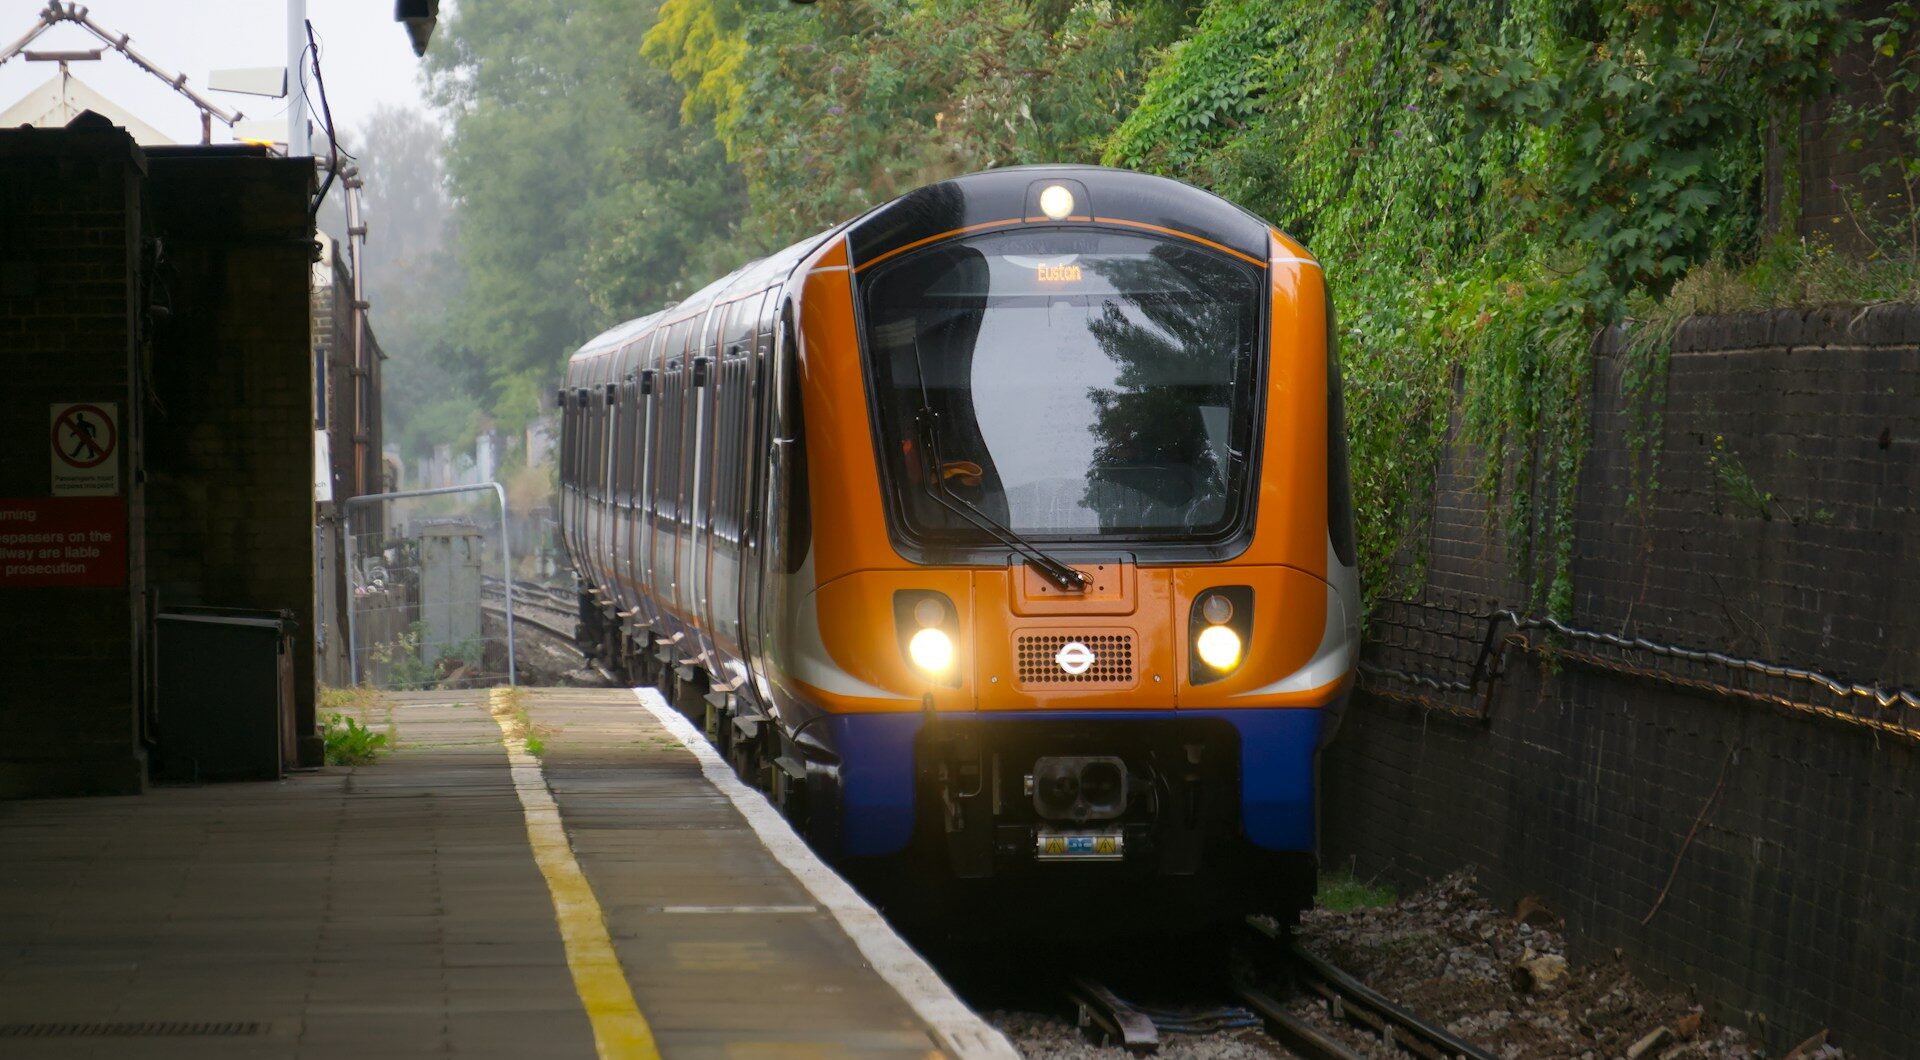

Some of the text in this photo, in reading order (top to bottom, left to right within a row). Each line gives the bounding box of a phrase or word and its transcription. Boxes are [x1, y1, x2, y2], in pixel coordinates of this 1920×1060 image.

[1038, 263, 1081, 281] Euston
[0, 531, 112, 545] spassers on the
[38, 548, 61, 559] are
[65, 546, 100, 558] liable
[6, 562, 86, 576] prosecution
